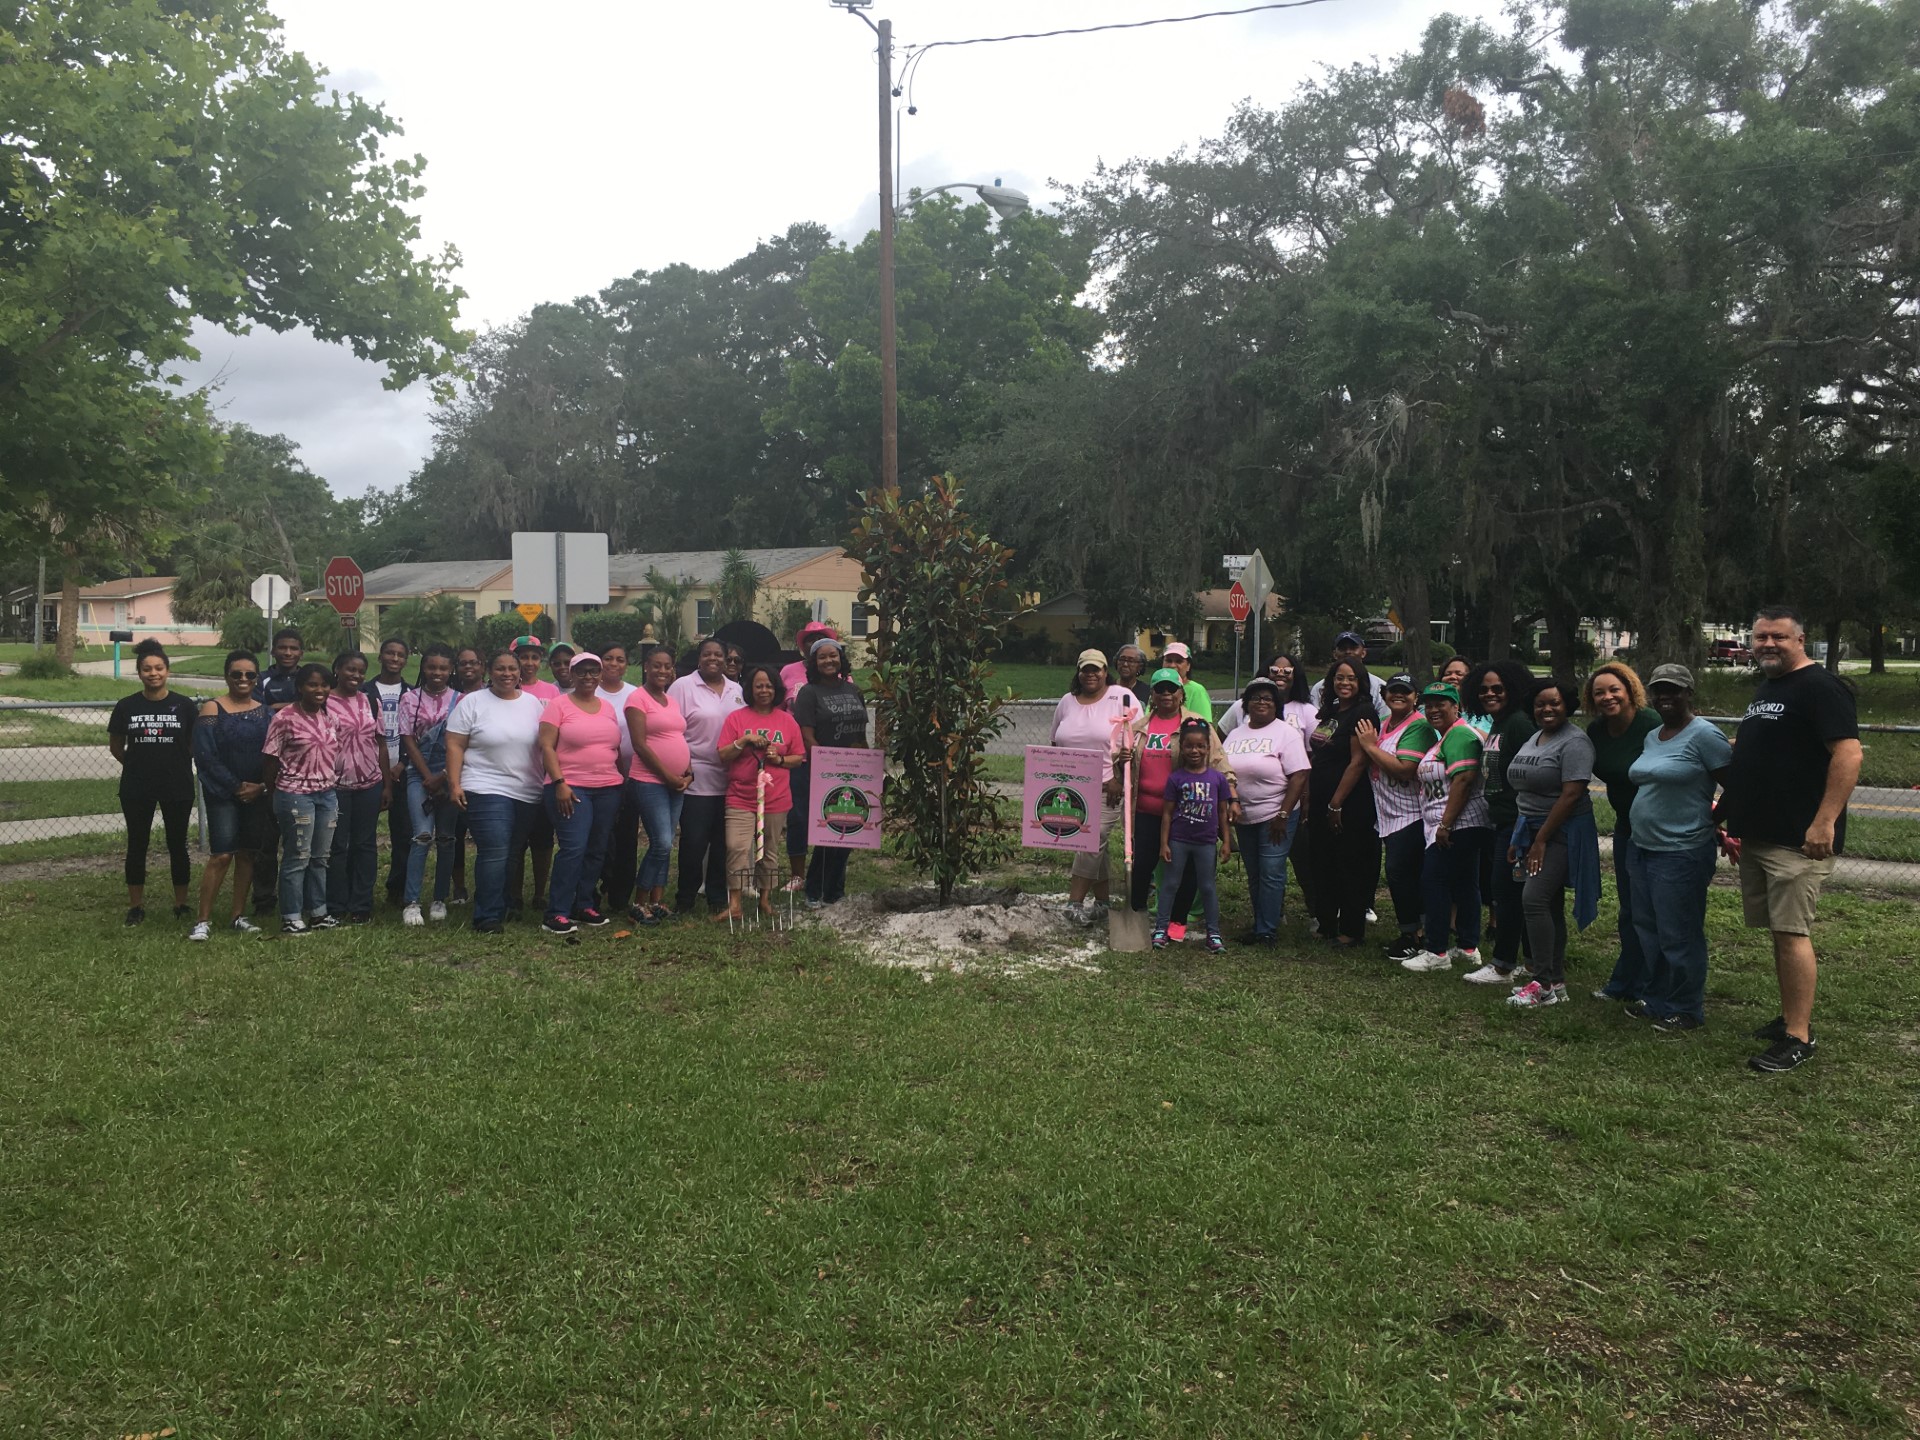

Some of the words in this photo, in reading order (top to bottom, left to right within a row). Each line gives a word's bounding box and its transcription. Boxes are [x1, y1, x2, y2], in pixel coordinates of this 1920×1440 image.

[328, 575, 362, 597] STOP
[1230, 593, 1249, 609] STOP
[827, 703, 864, 716] Coffee
[131, 714, 155, 723] WE'RE
[156, 714, 178, 722] HERE
[139, 736, 157, 744] LONG
[1225, 738, 1273, 755] AKA
[1181, 781, 1214, 801] GIRL
